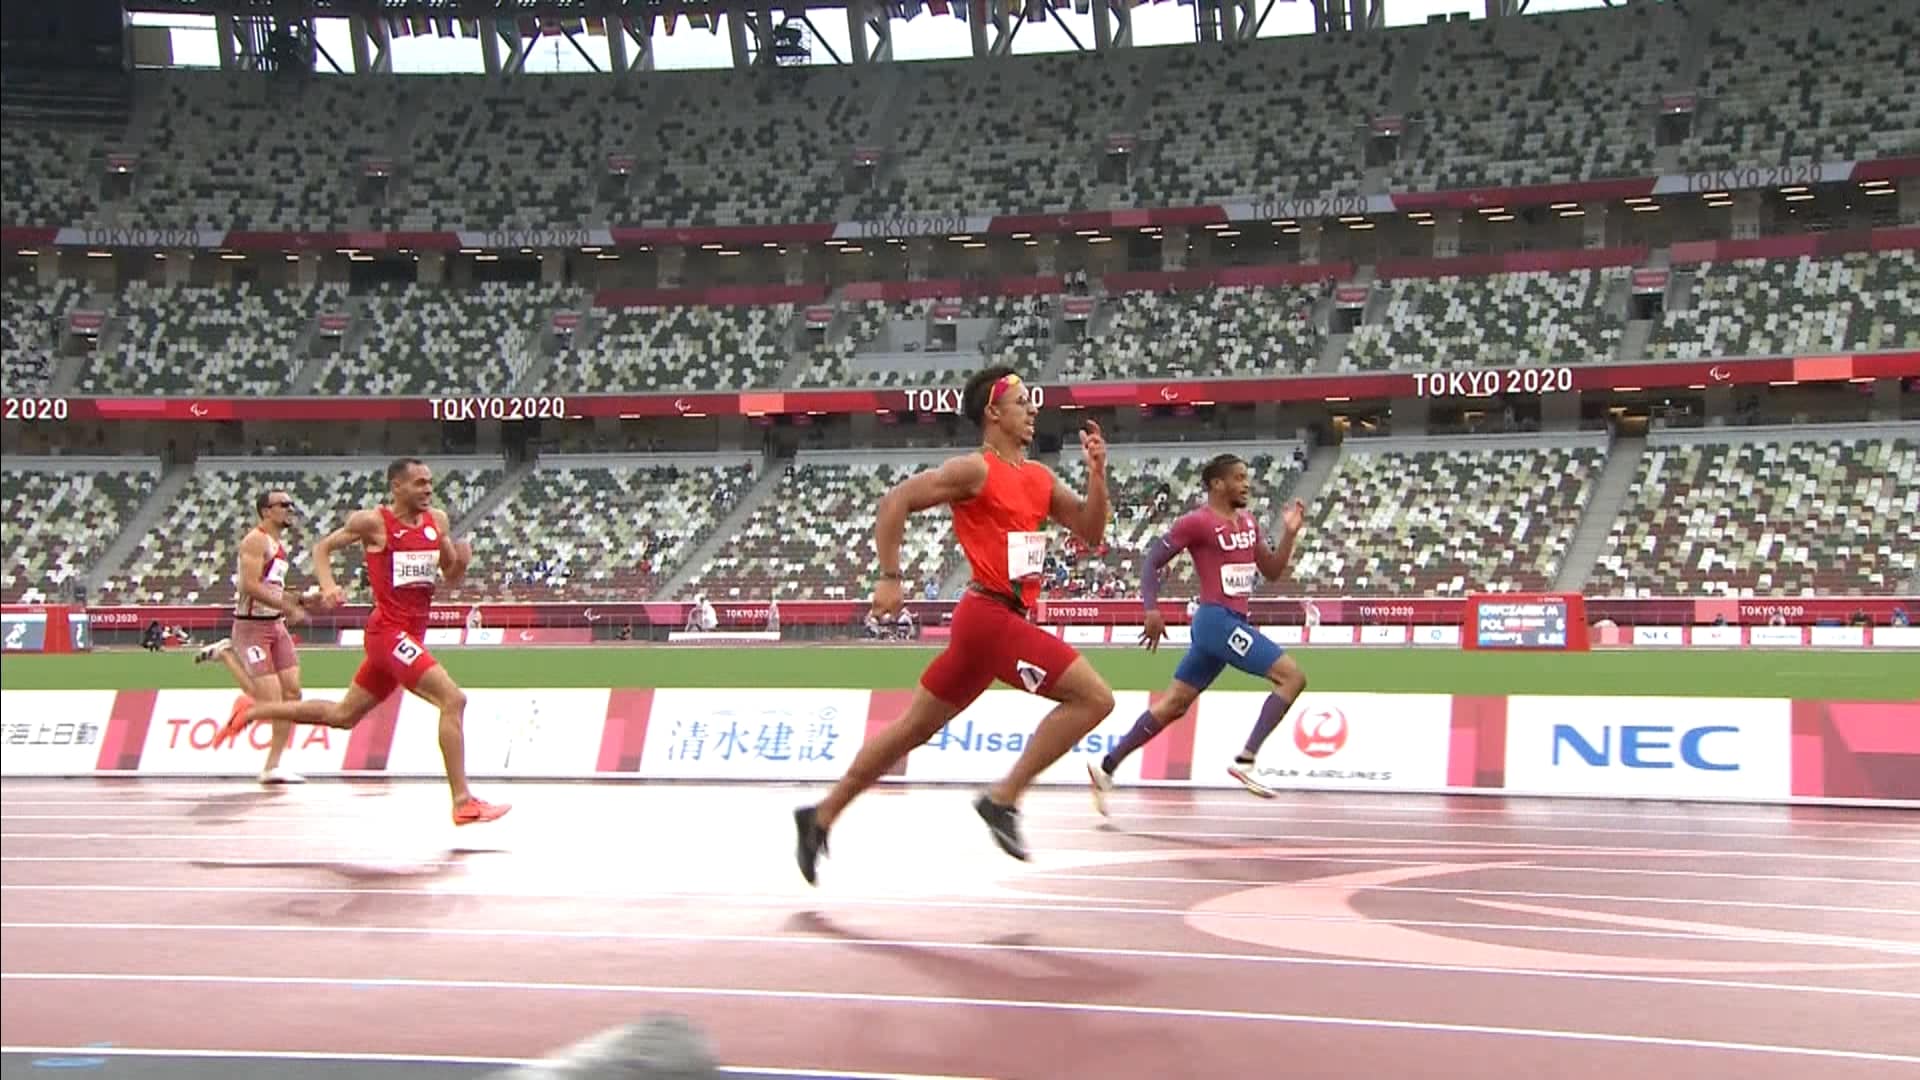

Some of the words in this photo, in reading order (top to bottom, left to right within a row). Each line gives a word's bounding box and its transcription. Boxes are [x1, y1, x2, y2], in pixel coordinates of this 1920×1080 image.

[1684, 167, 1759, 192] TOKYO
[1767, 163, 1822, 186] 2020
[1250, 199, 1314, 220] TOKYO
[1321, 195, 1368, 217] 2020
[86, 228, 147, 246] TOKYO
[153, 228, 200, 246] 2020
[485, 230, 542, 246] TOKYO
[549, 229, 590, 246] 2020
[861, 217, 917, 238] TOKYO
[923, 215, 967, 235] 2020
[1413, 371, 1499, 396] TOKYO
[1507, 368, 1572, 393] 2020
[6, 398, 67, 419] 2020
[430, 398, 504, 419] TOKYO
[510, 397, 565, 419] 2020
[905, 389, 964, 411] TOKY
[1217, 529, 1257, 551] USA
[726, 609, 753, 618] TOKYO
[754, 609, 769, 618] 202
[1048, 607, 1076, 617] TOKYO
[1077, 607, 1098, 617] 2020
[1360, 606, 1390, 617] TOKYO
[1391, 606, 1414, 617] 2020
[397, 642, 417, 660] 5
[1231, 633, 1249, 651] 3
[668, 720, 840, 761] 清水建設
[1552, 724, 1740, 770] NEC
